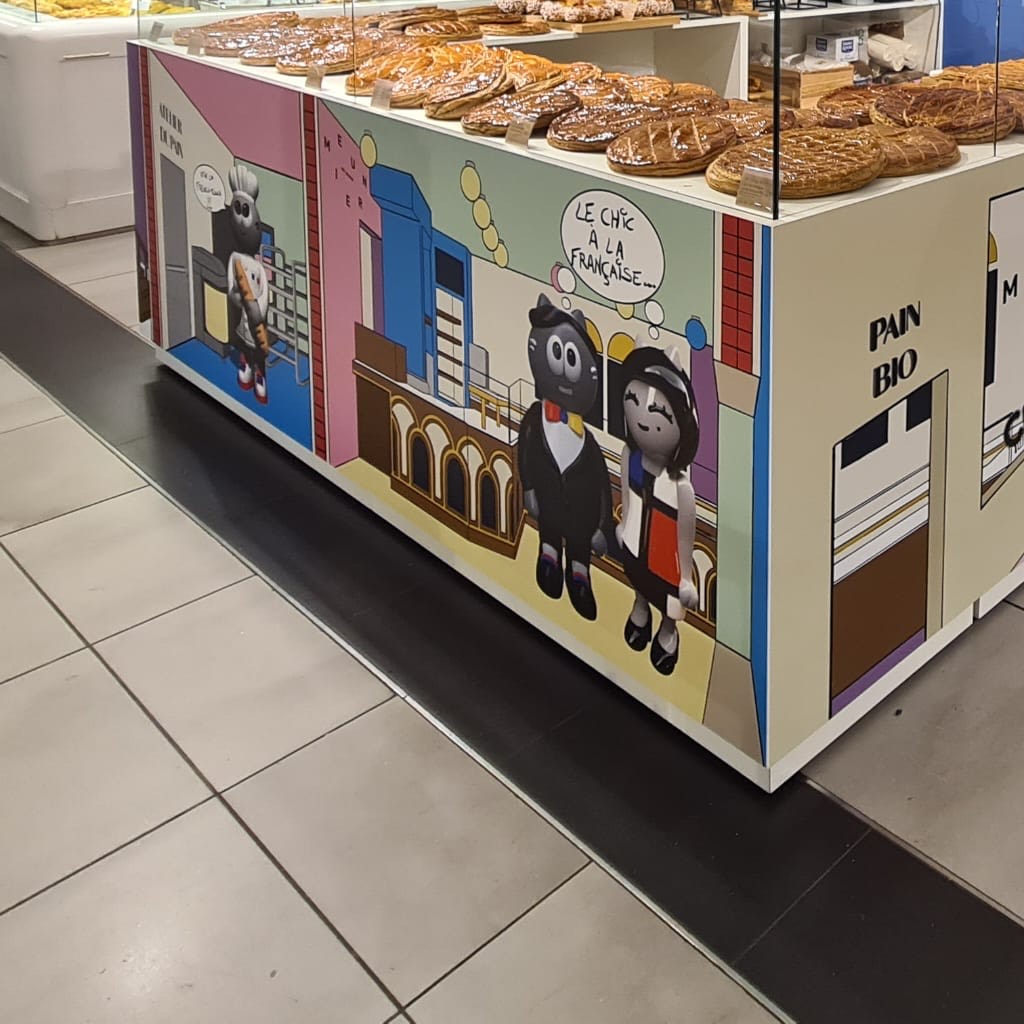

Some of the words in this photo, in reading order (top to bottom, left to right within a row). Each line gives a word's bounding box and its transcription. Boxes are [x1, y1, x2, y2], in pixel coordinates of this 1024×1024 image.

[575, 201, 595, 223] LE
[605, 237, 624, 260] LA
[869, 300, 921, 352] PAIN
[872, 348, 918, 399] BIO
